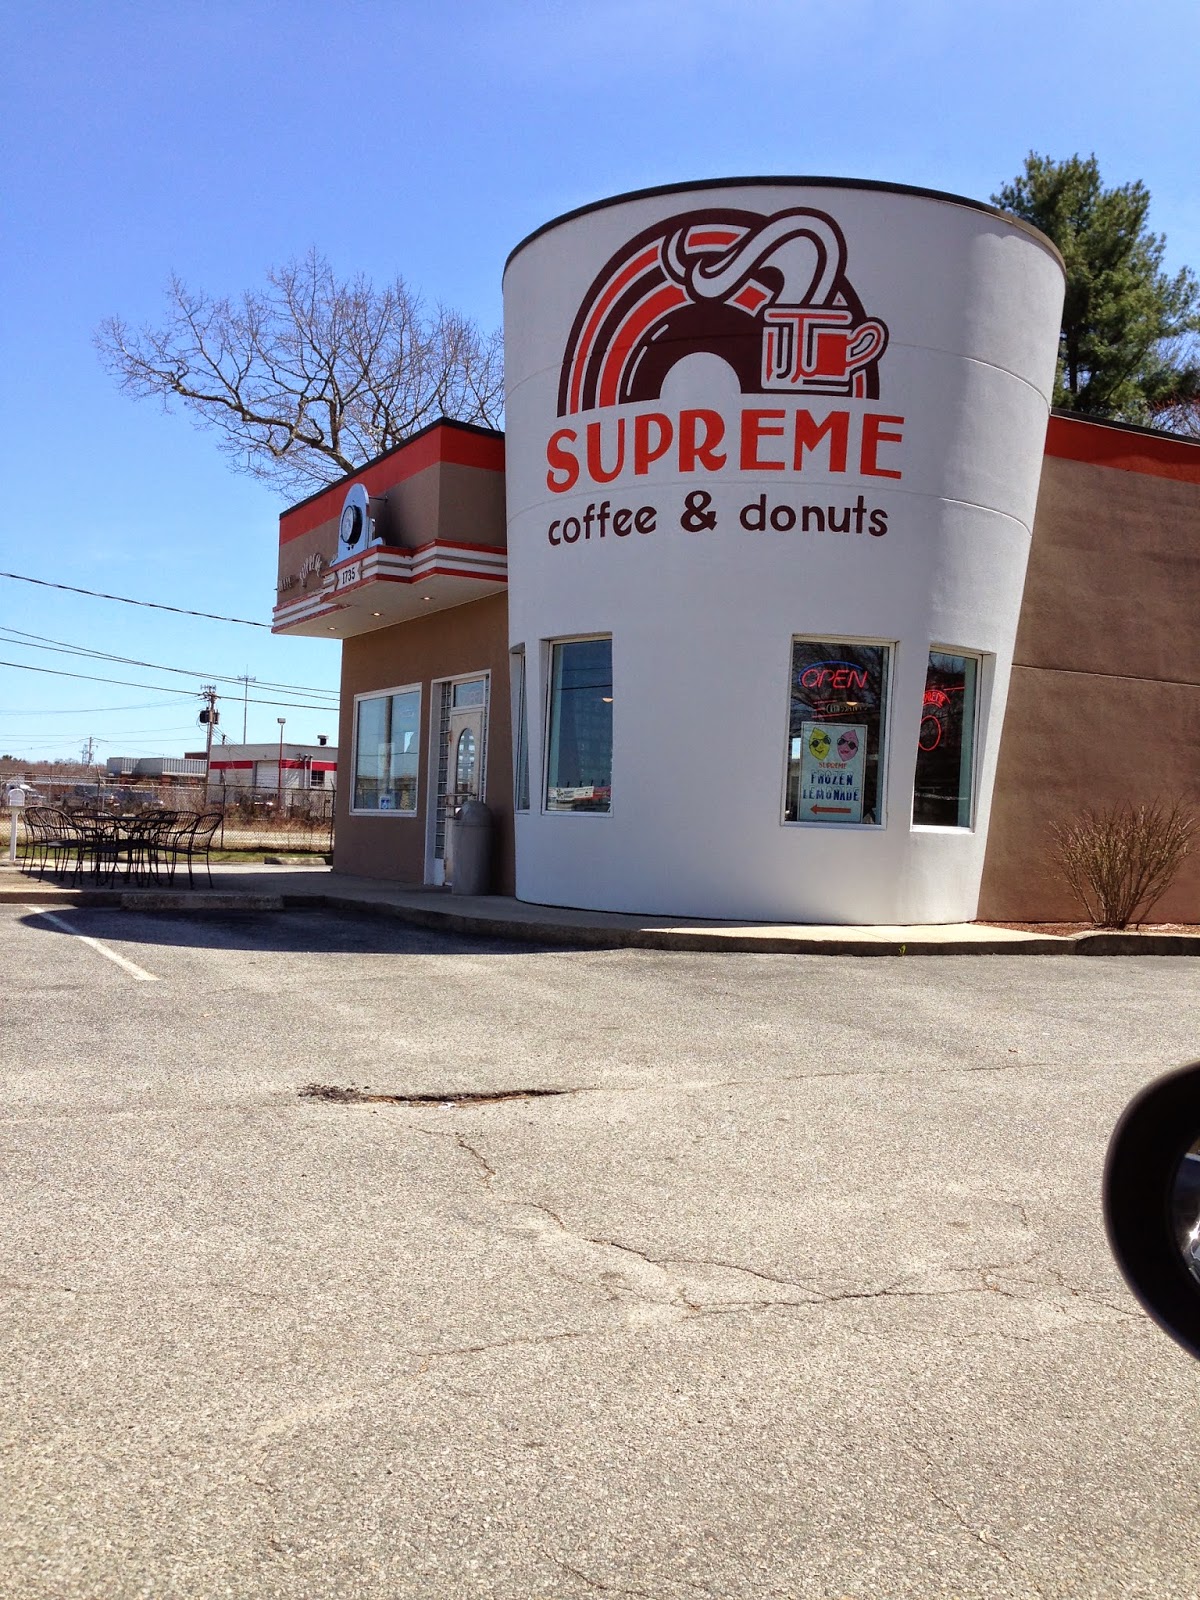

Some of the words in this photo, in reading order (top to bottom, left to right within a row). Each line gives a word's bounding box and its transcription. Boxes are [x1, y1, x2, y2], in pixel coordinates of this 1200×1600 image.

[547, 408, 905, 493] SUPREME
[549, 500, 657, 545] coffee
[681, 490, 717, 533] &
[740, 493, 889, 536] donuts
[342, 567, 356, 584] 1735
[801, 668, 868, 689] OPEN
[810, 769, 854, 786] FROZEN
[802, 785, 860, 801] LEMONADE
